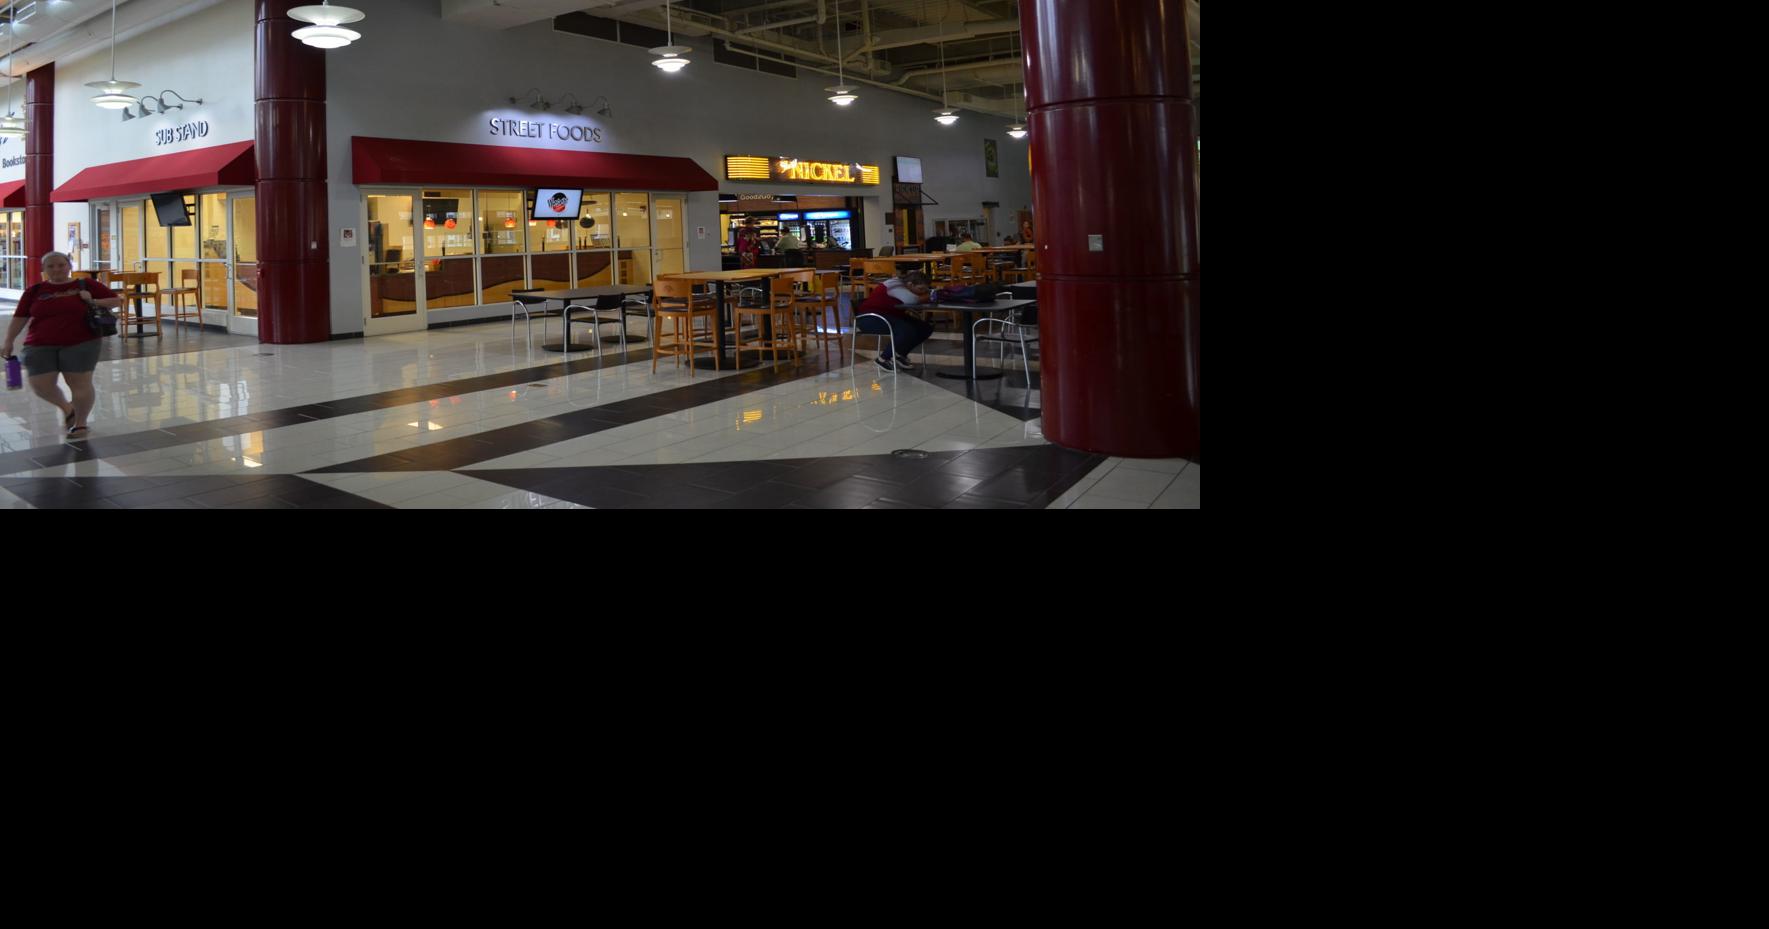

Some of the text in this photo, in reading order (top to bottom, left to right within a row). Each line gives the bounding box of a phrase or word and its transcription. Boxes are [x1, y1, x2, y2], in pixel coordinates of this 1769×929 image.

[155, 120, 209, 146] SUB STAND
[489, 117, 601, 143] STREET FOODS
[789, 161, 856, 183] NICKEL
